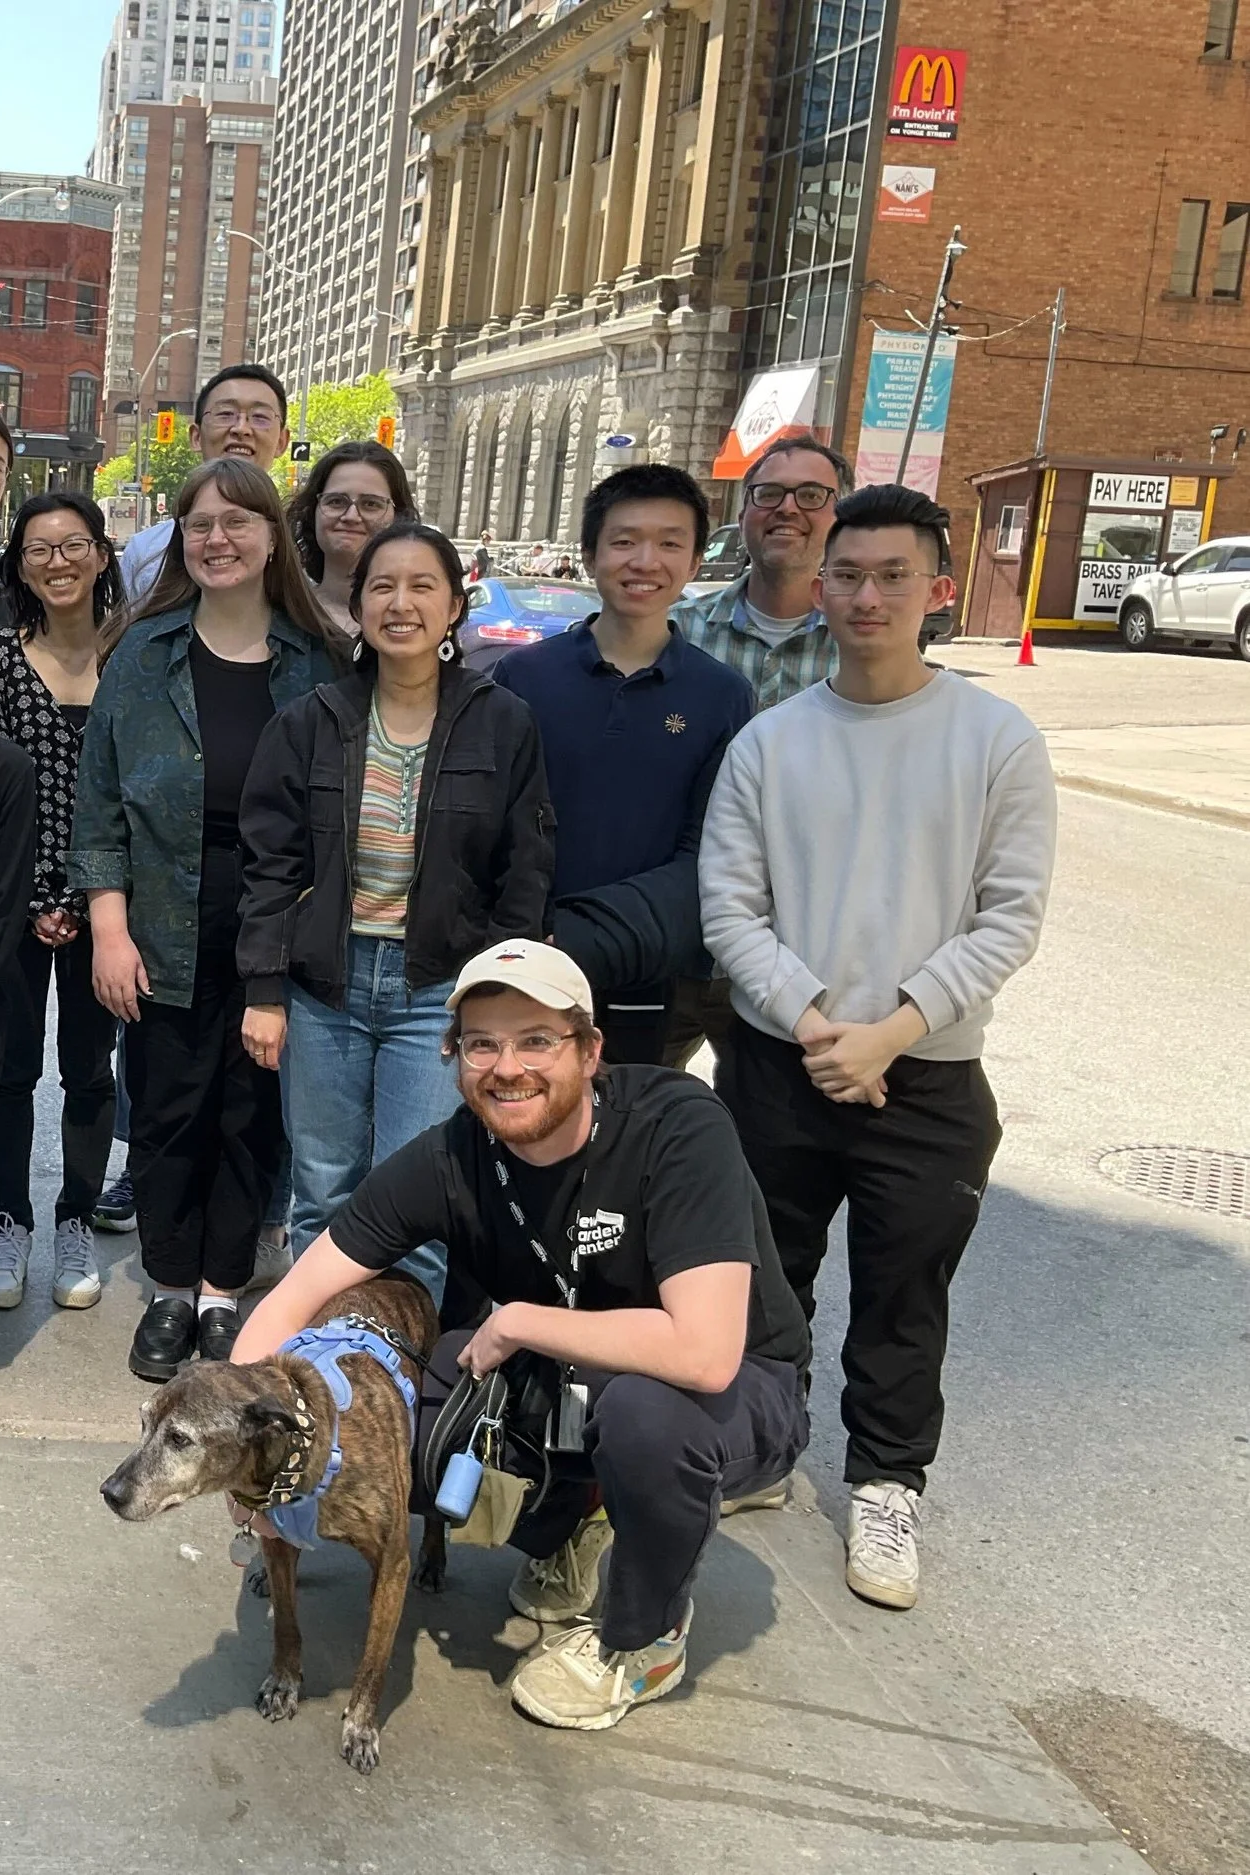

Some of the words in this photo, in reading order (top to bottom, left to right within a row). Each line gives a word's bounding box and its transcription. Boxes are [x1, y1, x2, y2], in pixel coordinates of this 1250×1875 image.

[892, 105, 910, 118] i'm
[913, 106, 945, 120] lovin'
[946, 109, 958, 121] it
[890, 127, 901, 135] ON
[902, 128, 925, 136] YONGE
[926, 130, 952, 139] STREET
[904, 122, 939, 131] ENTRANCE
[895, 183, 919, 194] NANI'S
[880, 340, 946, 353] PHYSIOMD
[886, 357, 904, 366] PAIN
[1094, 478, 1123, 501] PAY
[1126, 480, 1165, 504] HERE
[110, 506, 137, 518] FedE
[1081, 563, 1122, 580] BRASS
[1092, 583, 1126, 600] TAVE
[577, 1225, 623, 1242] arden
[577, 1236, 621, 1255] enter
